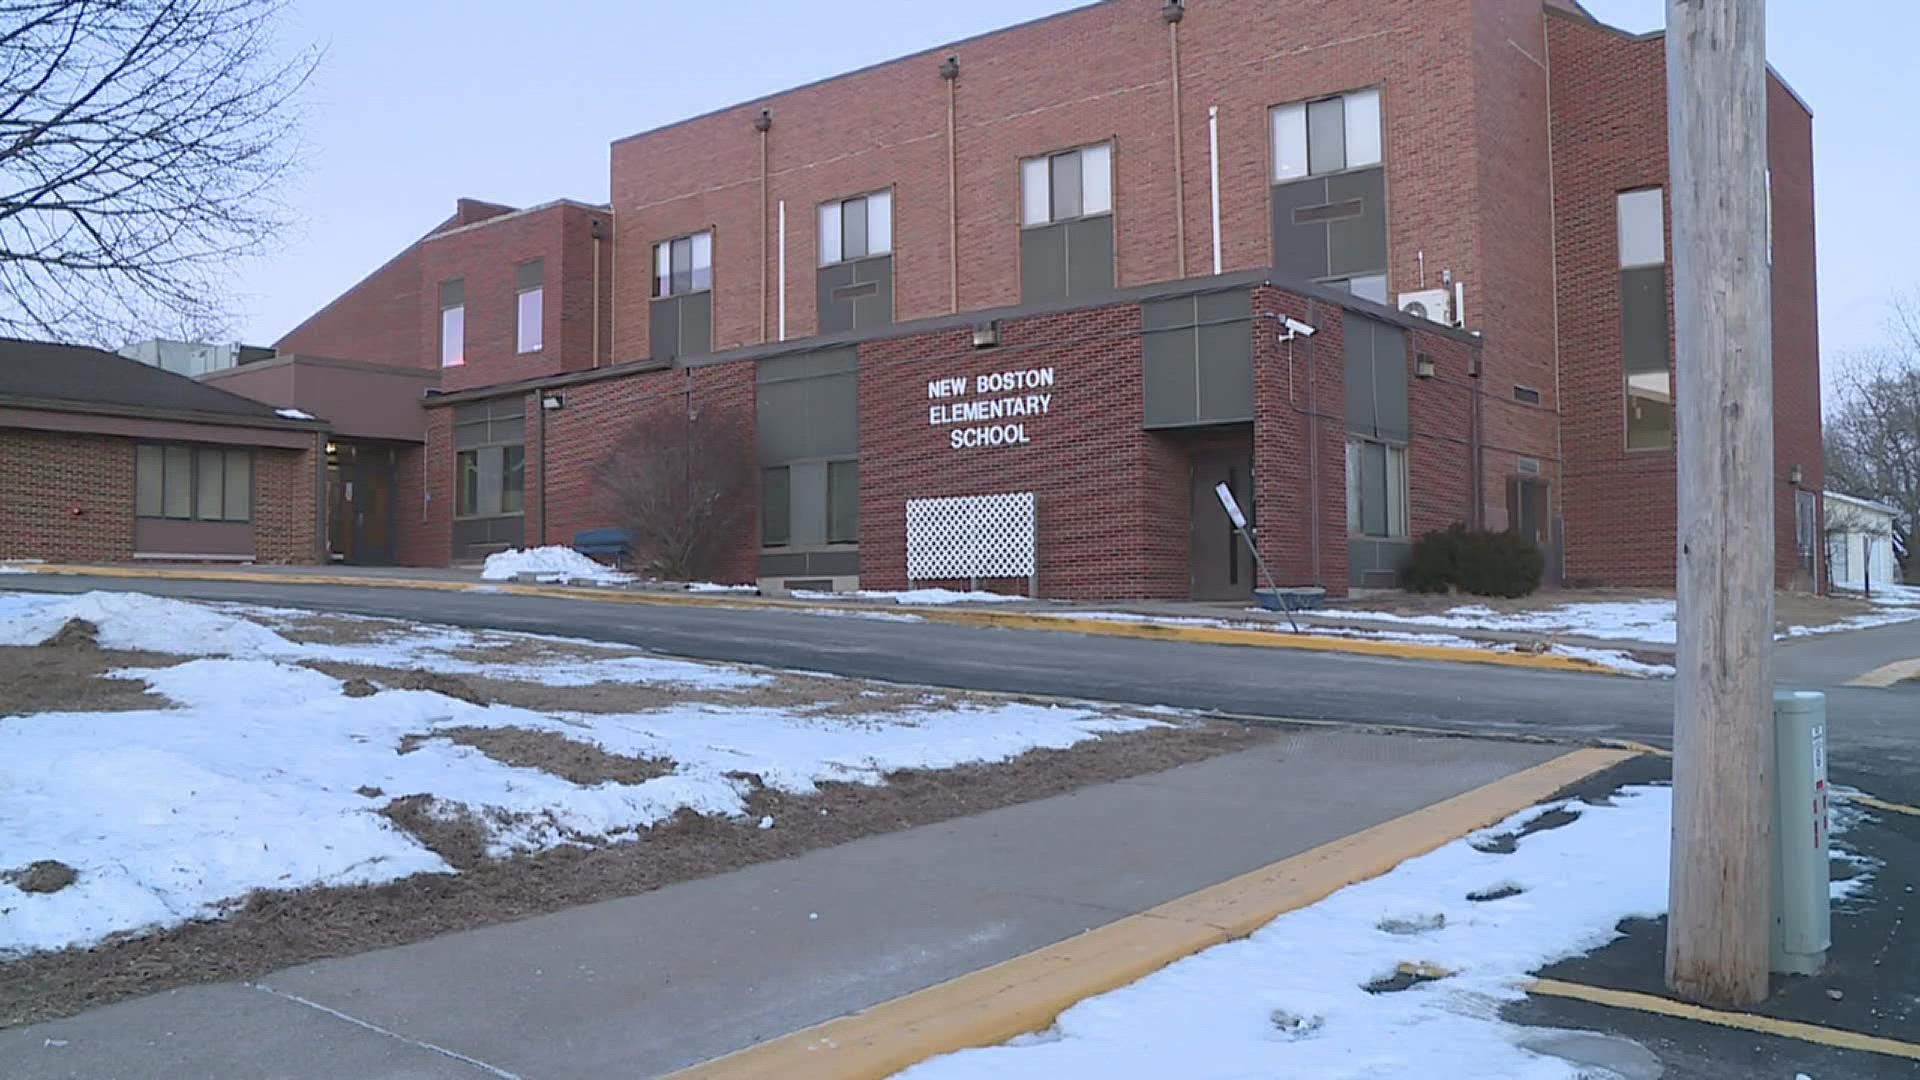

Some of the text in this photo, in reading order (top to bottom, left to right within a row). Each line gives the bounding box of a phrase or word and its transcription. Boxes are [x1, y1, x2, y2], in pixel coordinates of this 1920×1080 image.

[928, 367, 1054, 398] NEW BOSTON
[929, 394, 1051, 424] ELEMENTARY
[951, 424, 1030, 448] SCHOOL
